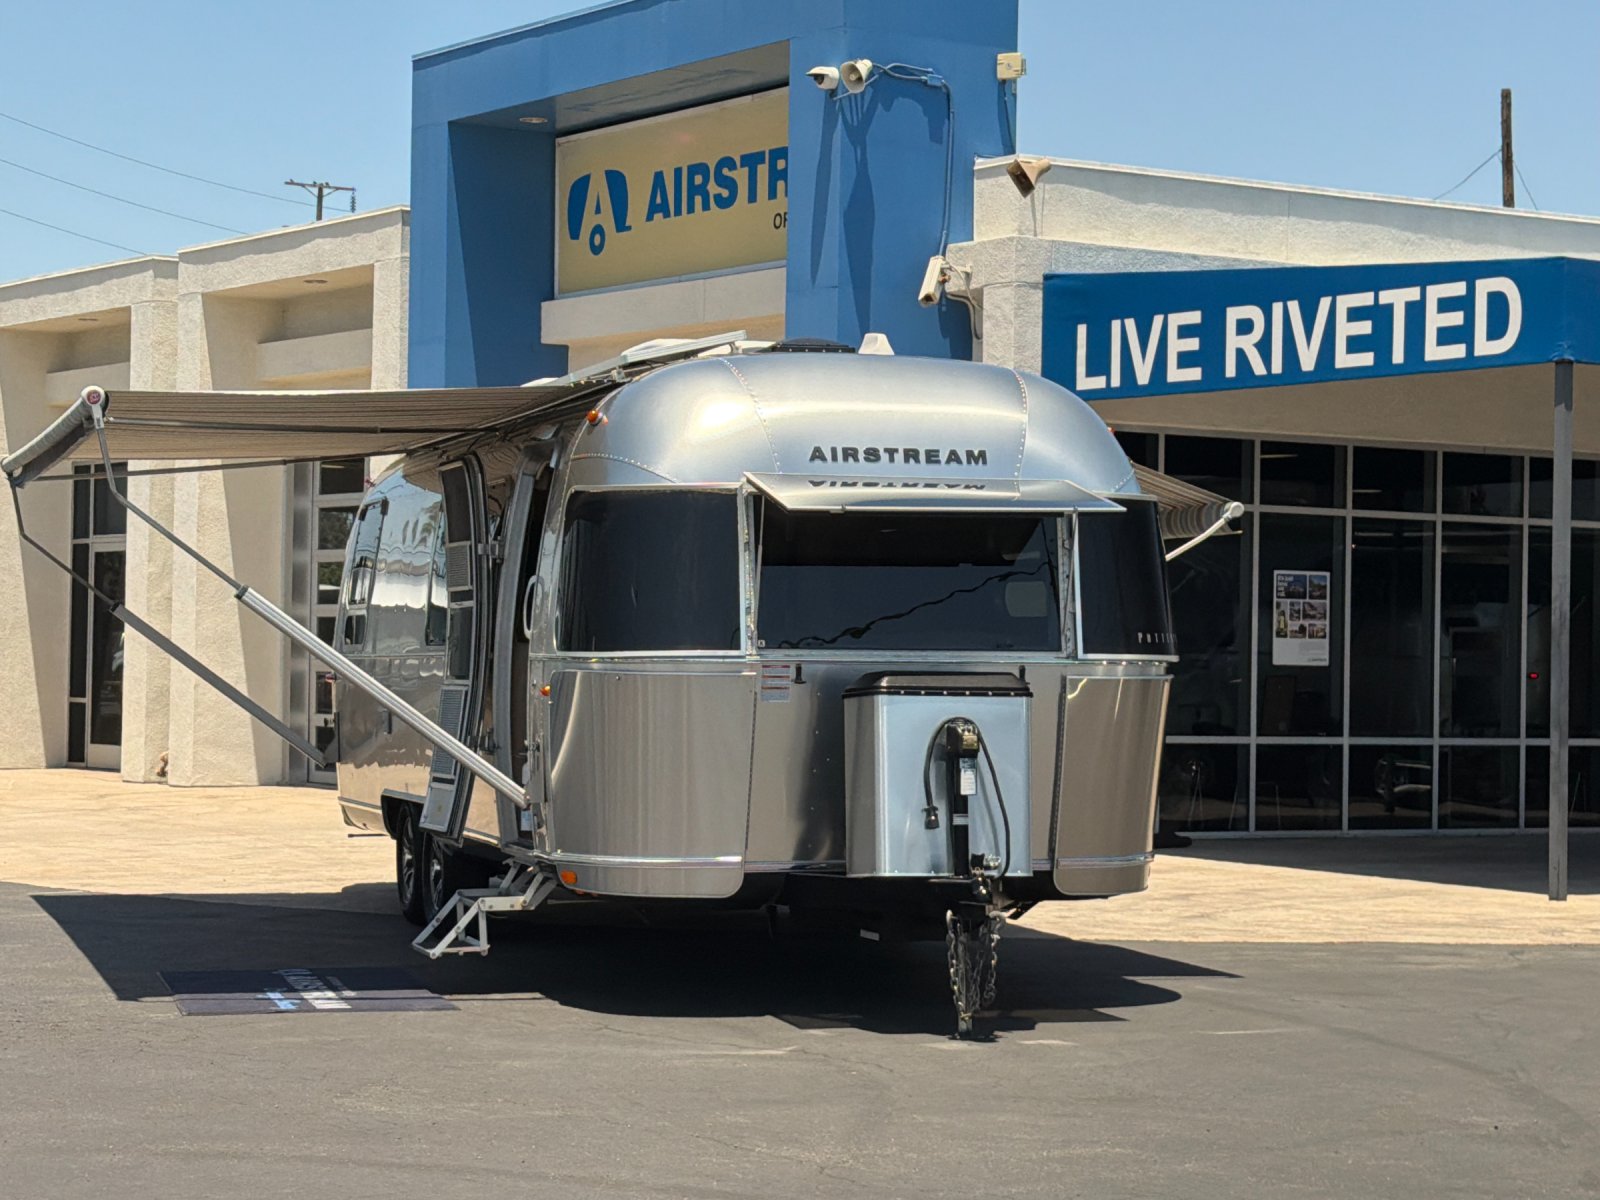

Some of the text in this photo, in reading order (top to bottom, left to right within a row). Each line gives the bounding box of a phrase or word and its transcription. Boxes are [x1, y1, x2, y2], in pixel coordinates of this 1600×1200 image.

[1075, 276, 1522, 391] LIVE RIVETED
[809, 446, 988, 466] AIRSTREAM
